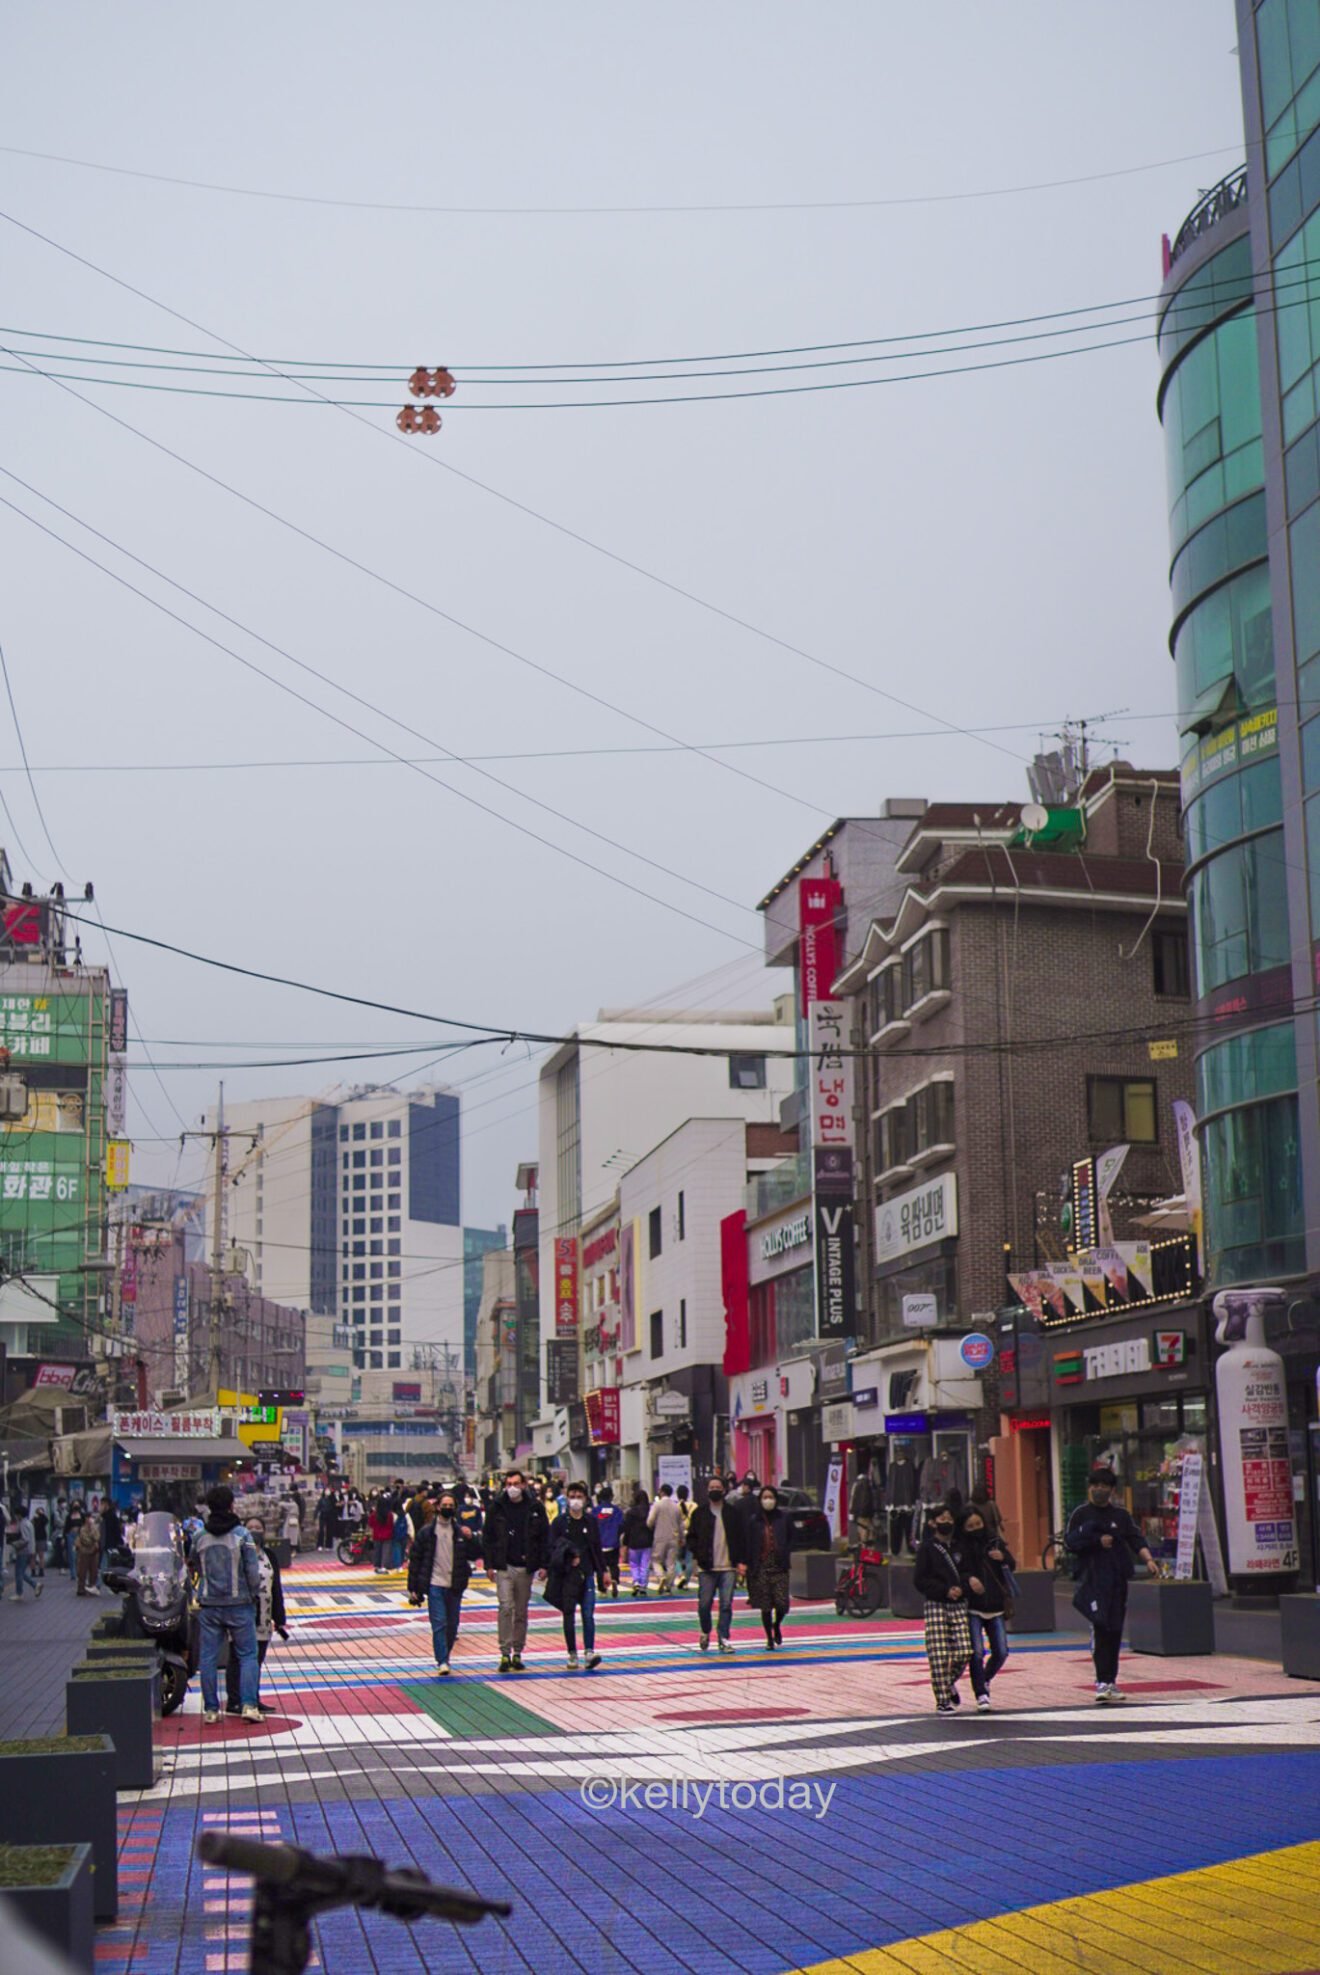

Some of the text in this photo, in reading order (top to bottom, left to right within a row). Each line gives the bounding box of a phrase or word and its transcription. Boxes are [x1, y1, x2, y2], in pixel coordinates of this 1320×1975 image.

[0, 1012, 51, 1032] 블리
[0, 1035, 51, 1055] 카페
[56, 1176, 78, 1200] 6F
[900, 1184, 945, 1244] 육쌈냉면
[783, 1215, 809, 1249] COFFEE
[829, 1288, 843, 1324] PLUS
[39, 1369, 71, 1391] bbq
[119, 1412, 214, 1433] 폰케이스 필름부착
[1282, 1550, 1298, 1568] 4F
